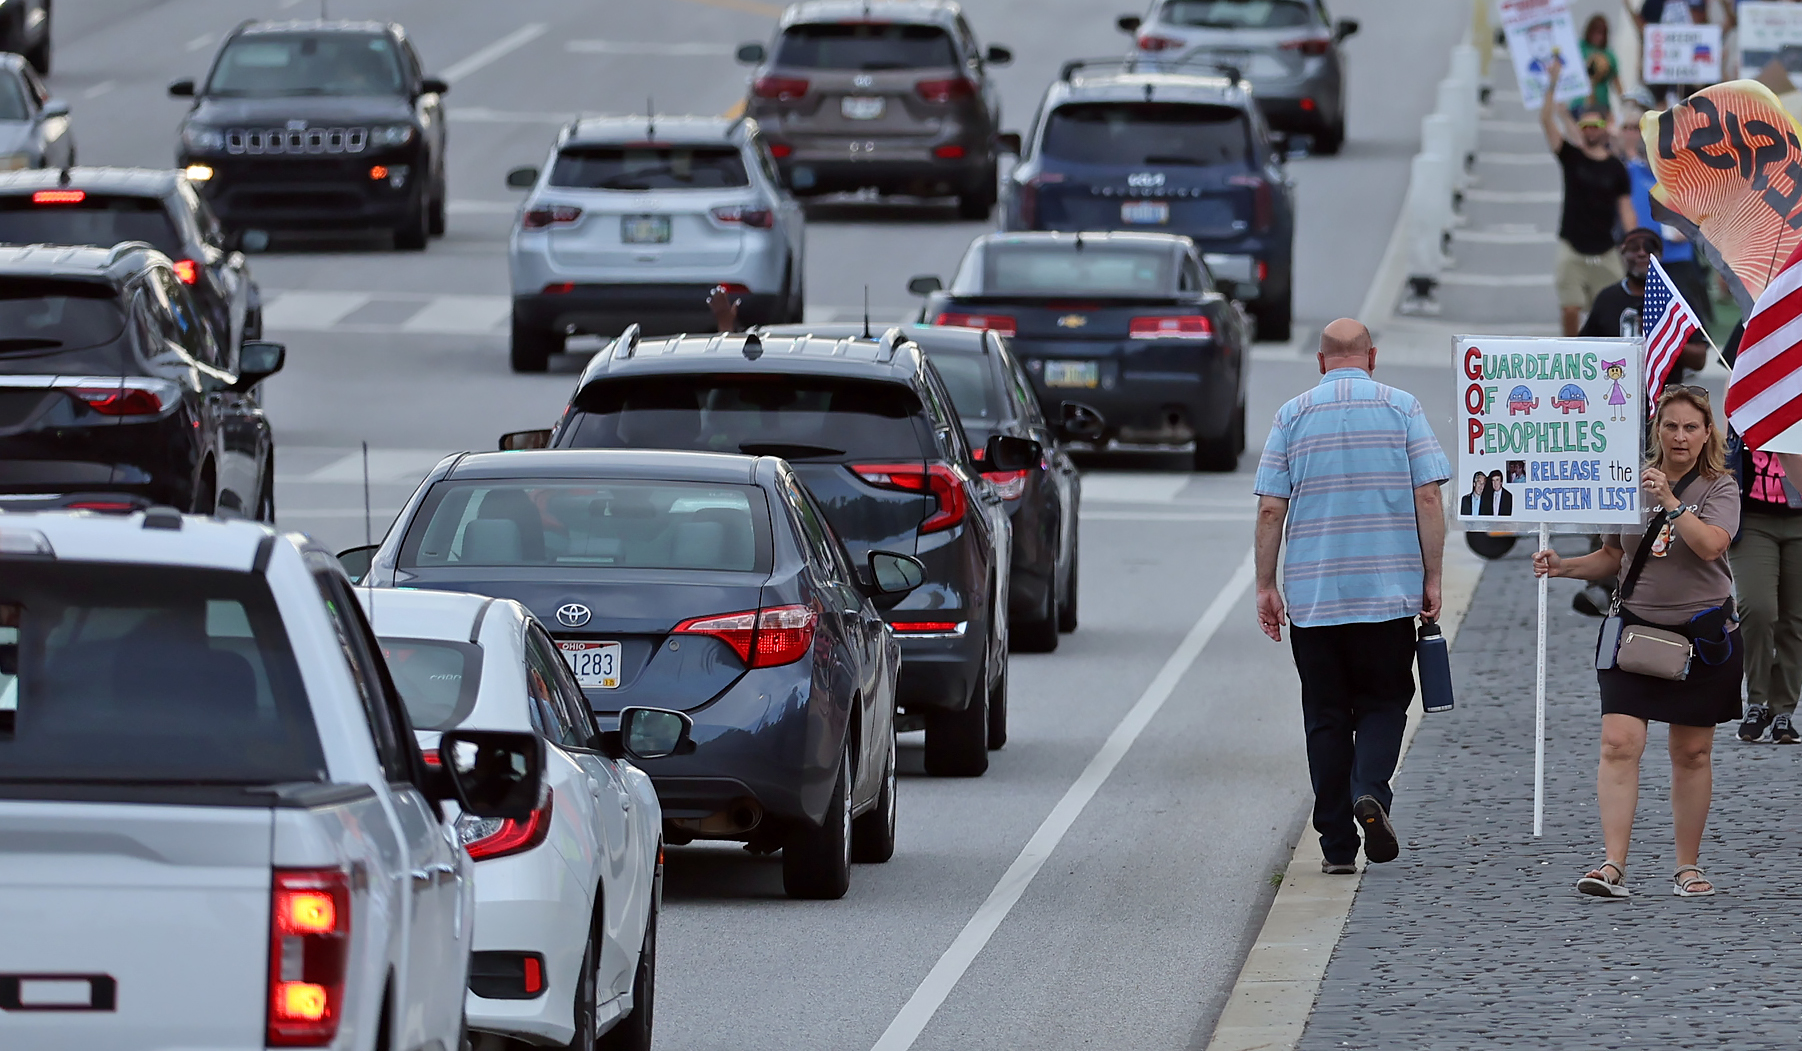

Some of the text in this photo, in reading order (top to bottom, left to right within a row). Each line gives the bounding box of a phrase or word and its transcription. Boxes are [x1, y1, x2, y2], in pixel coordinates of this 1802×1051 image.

[1531, 460, 1632, 483] RELEASE the
[1525, 488, 1591, 511] EPSTEIN
[1599, 487, 1637, 510] LIST
[562, 643, 586, 651] OHIO
